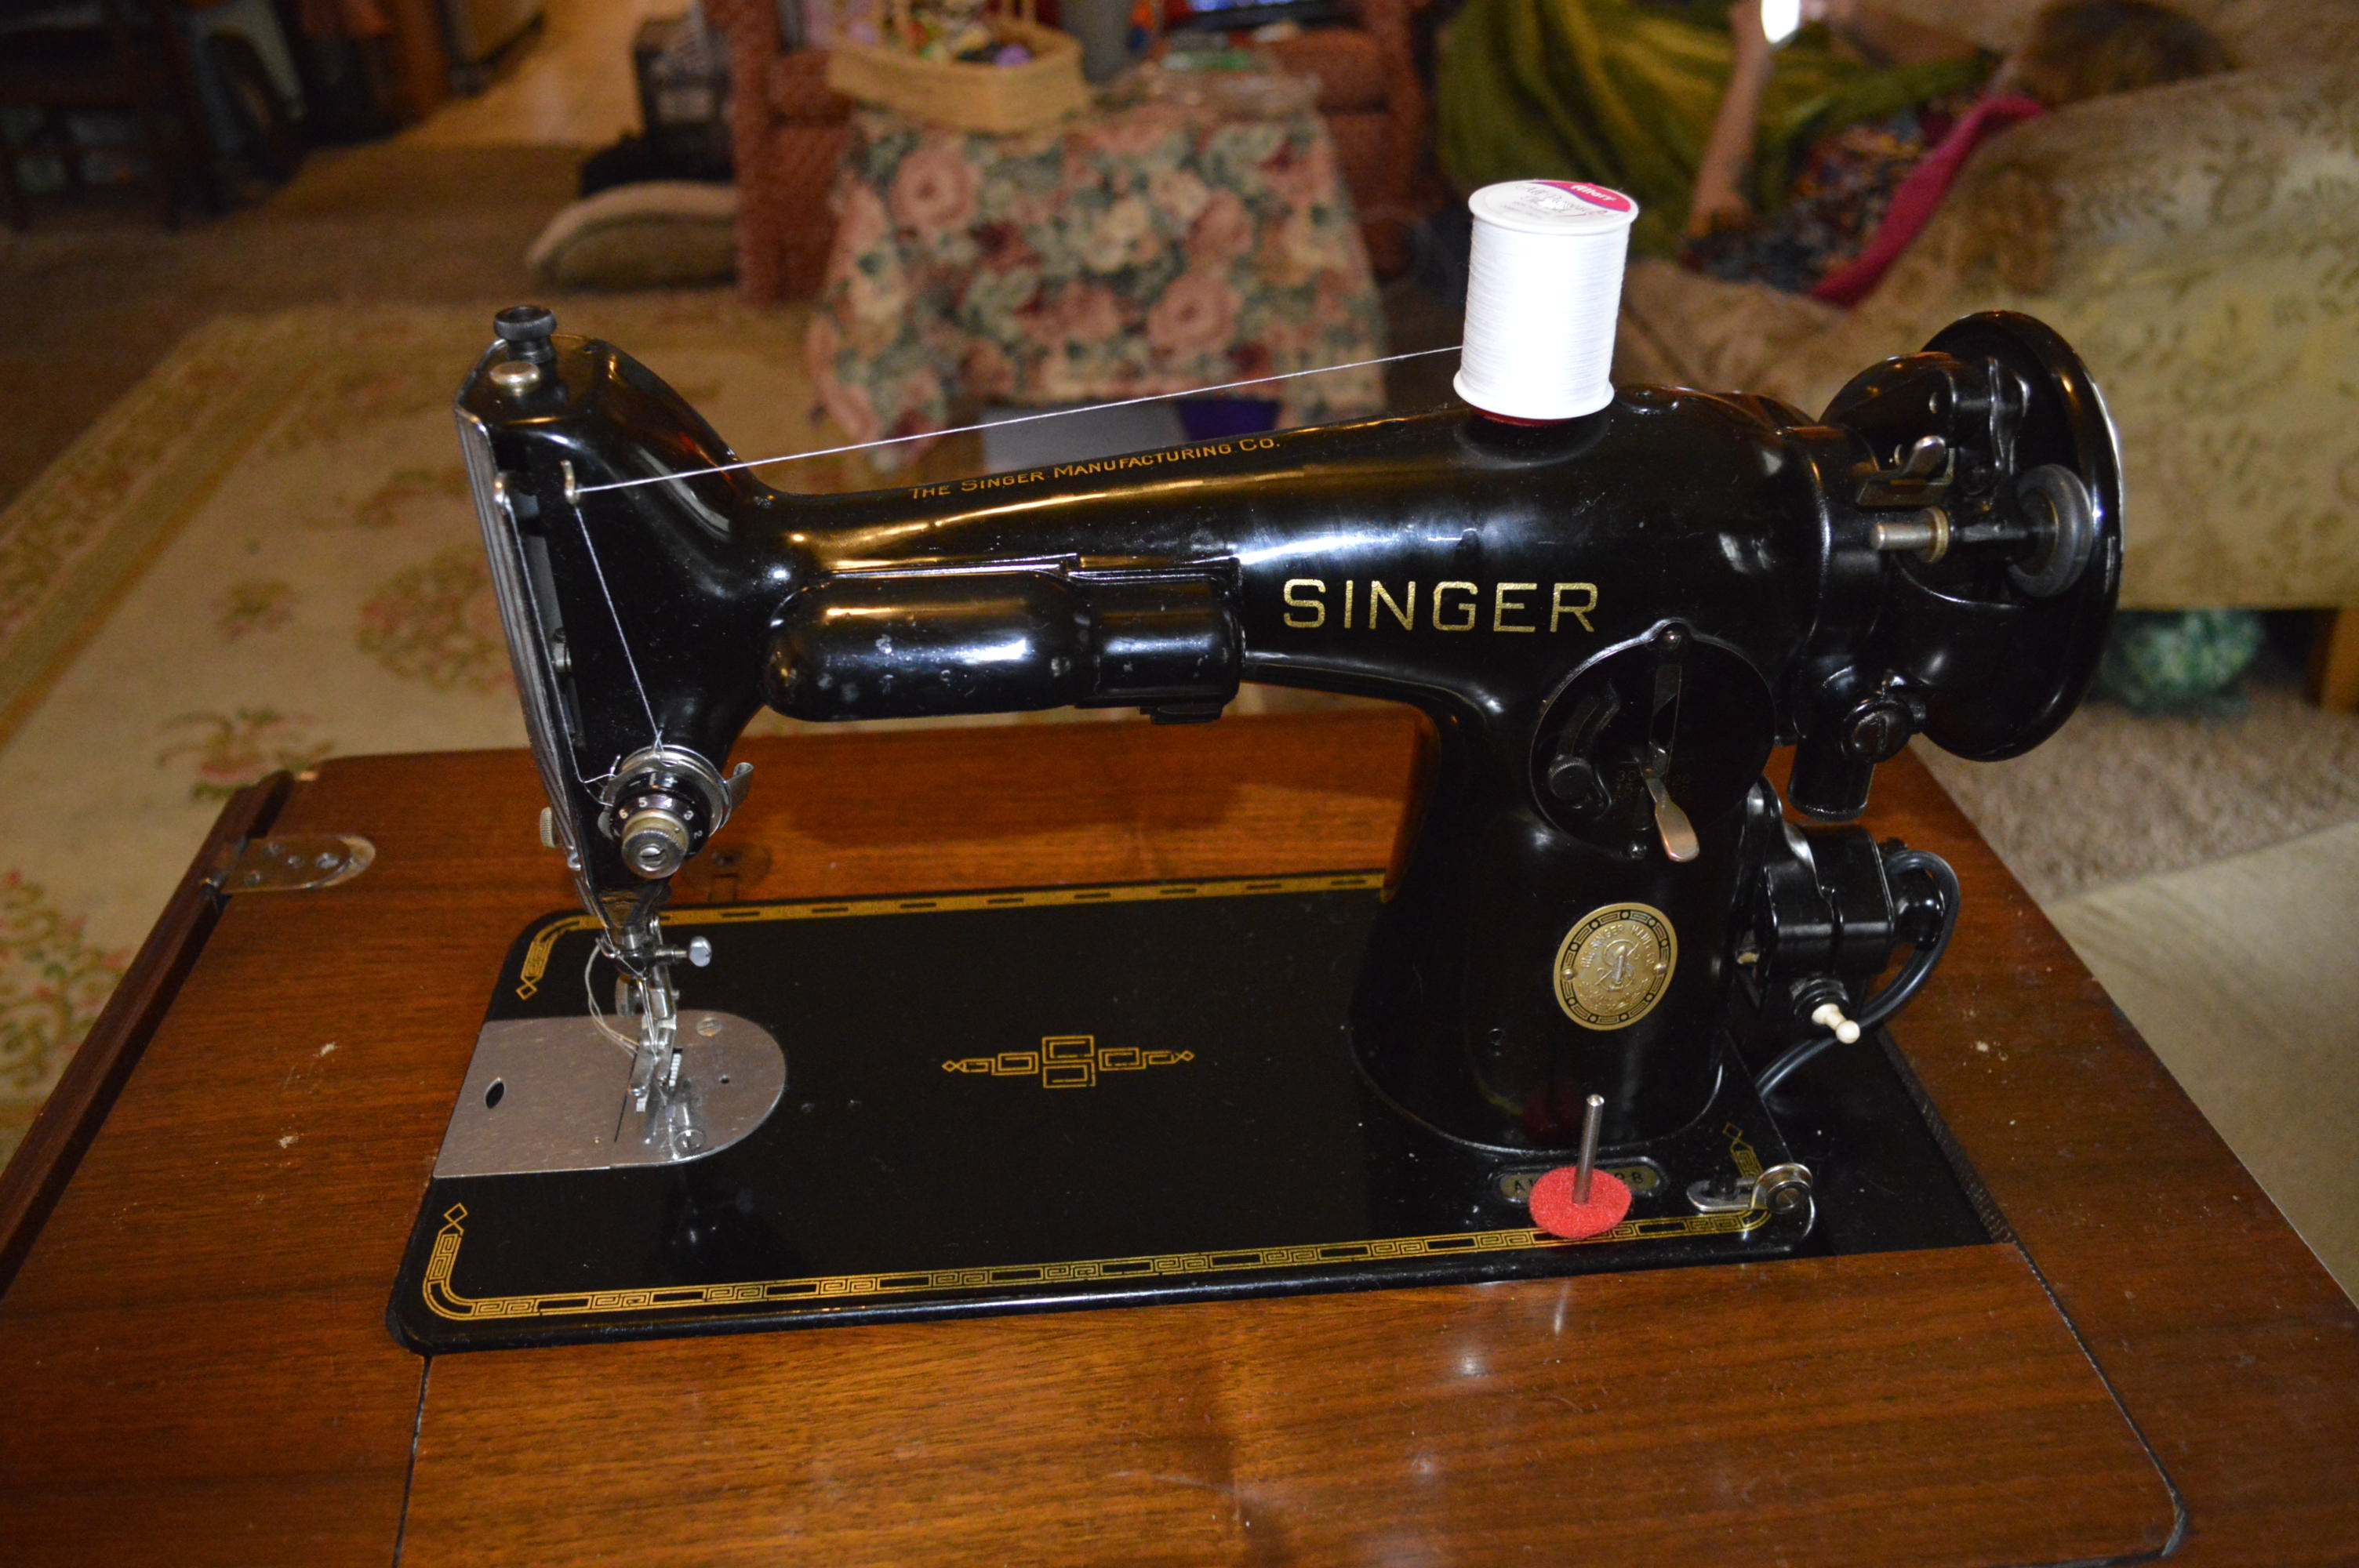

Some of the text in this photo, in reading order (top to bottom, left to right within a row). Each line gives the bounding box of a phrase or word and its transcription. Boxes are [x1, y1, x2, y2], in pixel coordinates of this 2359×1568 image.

[909, 488, 951, 500] THE
[961, 471, 1045, 492] SINGER
[1053, 444, 1232, 477] MANUFACTURING
[1284, 579, 1598, 633] SINGER
[619, 809, 628, 819] 6
[638, 797, 648, 808] 5
[662, 797, 673, 808] 4
[684, 811, 694, 821] 3
